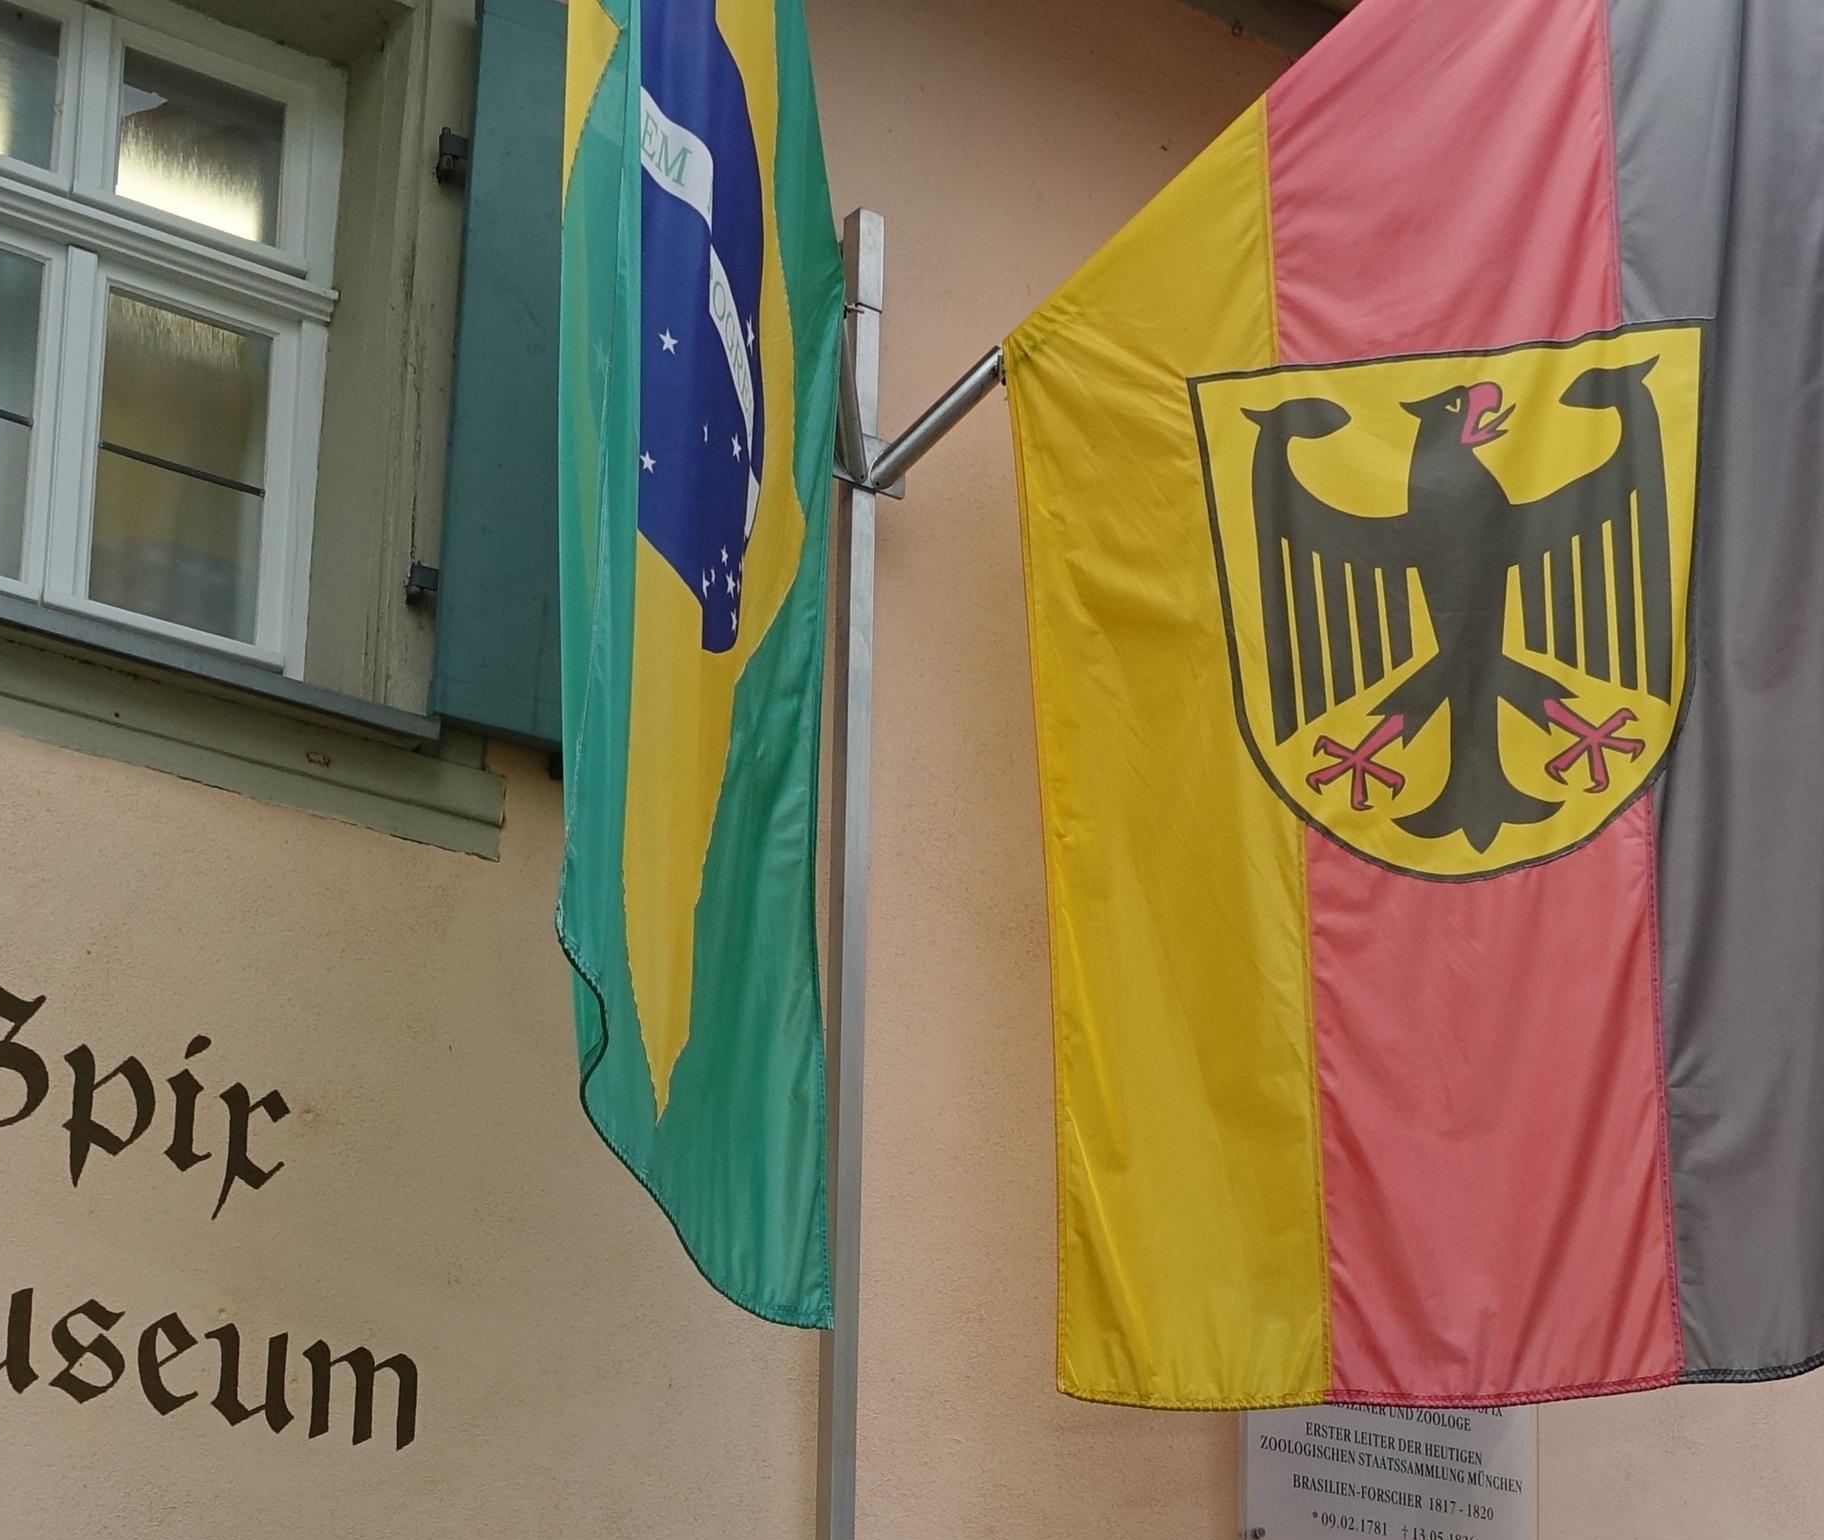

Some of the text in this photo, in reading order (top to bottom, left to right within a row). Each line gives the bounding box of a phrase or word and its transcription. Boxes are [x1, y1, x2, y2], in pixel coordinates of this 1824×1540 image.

[1416, 1408, 1471, 1432] ZOOLOGE
[1260, 1434, 1523, 1494] ZOOLOGISCHEN STAATSSAMMLUNG MÜNCHEN
[1305, 1421, 1483, 1466] ERSTER LEITER DER HEUTIGEN
[1292, 1473, 1423, 1509] BRASILIEN-FORSCHER
[1429, 1497, 1457, 1515] 1817
[1467, 1503, 1494, 1521] 1820
[1321, 1511, 1388, 1537] 09.02.1781
